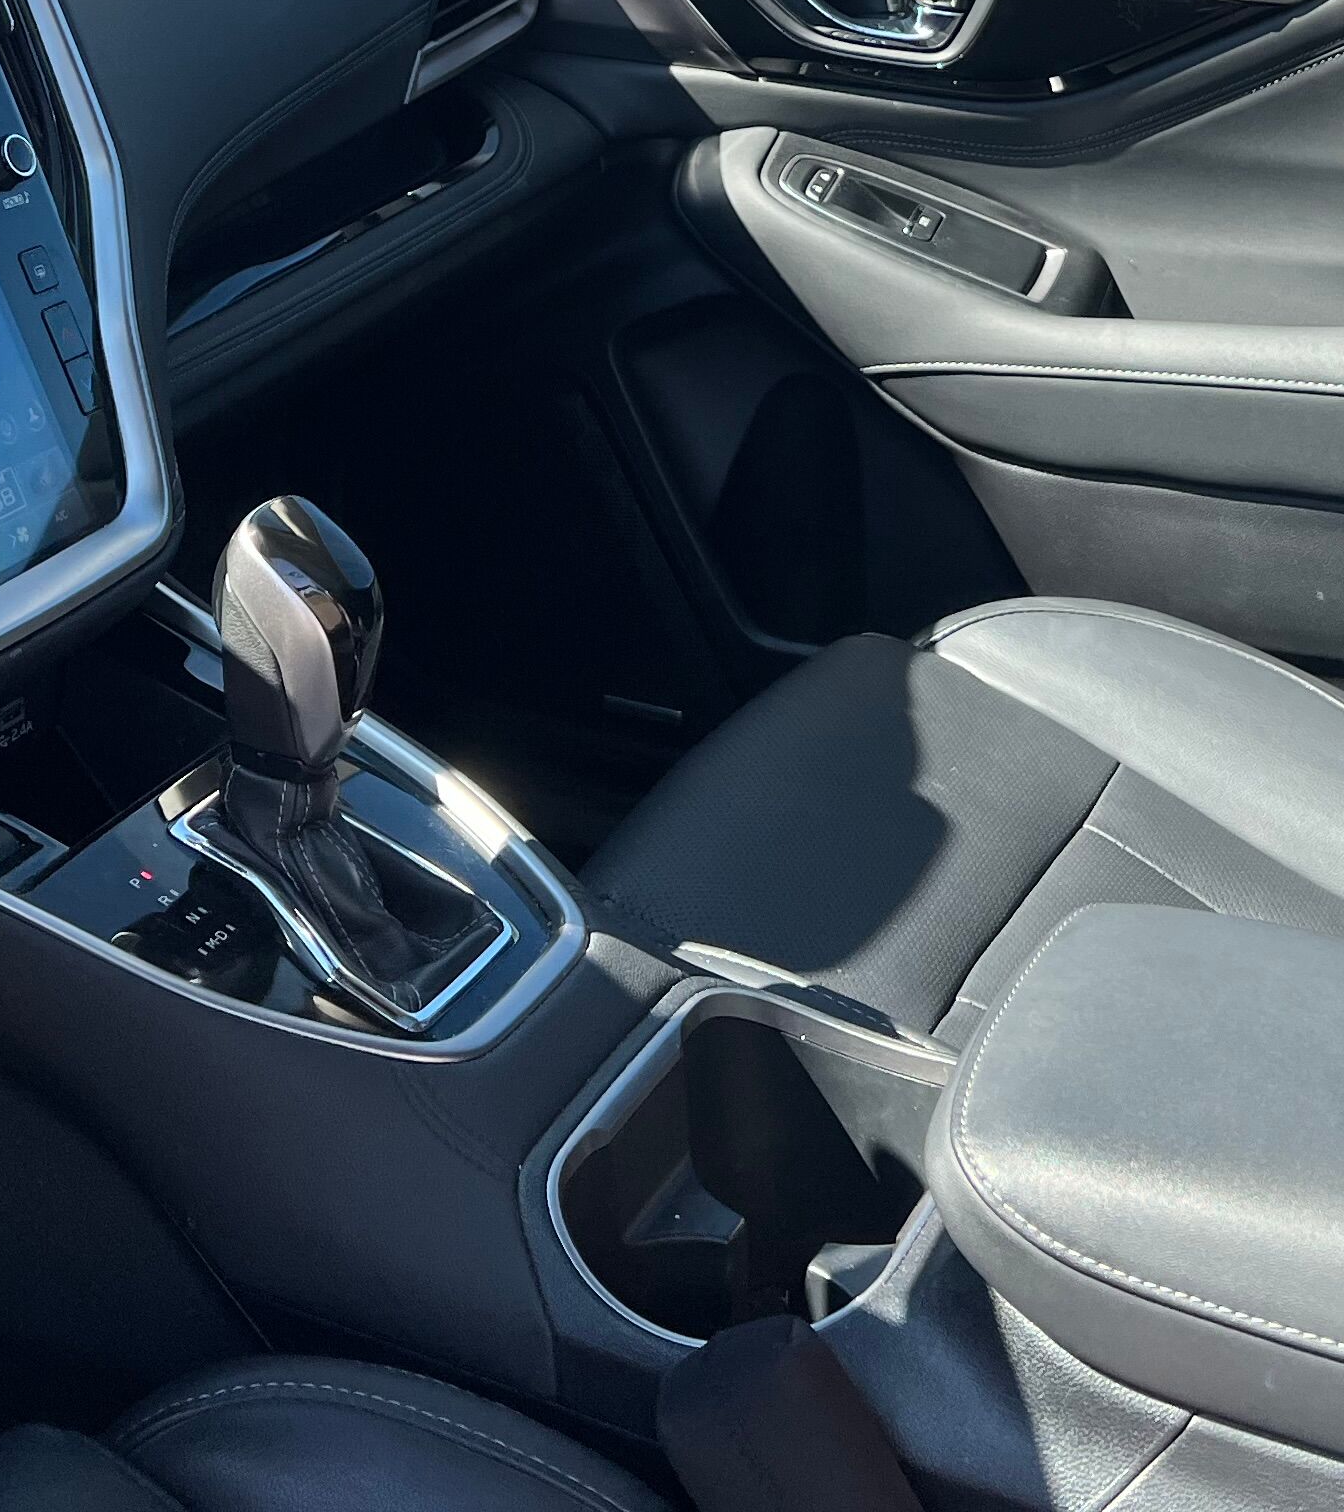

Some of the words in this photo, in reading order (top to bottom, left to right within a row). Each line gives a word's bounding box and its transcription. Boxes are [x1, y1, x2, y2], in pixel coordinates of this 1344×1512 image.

[129, 877, 142, 889] P
[158, 895, 173, 907] R
[185, 912, 201, 925] N
